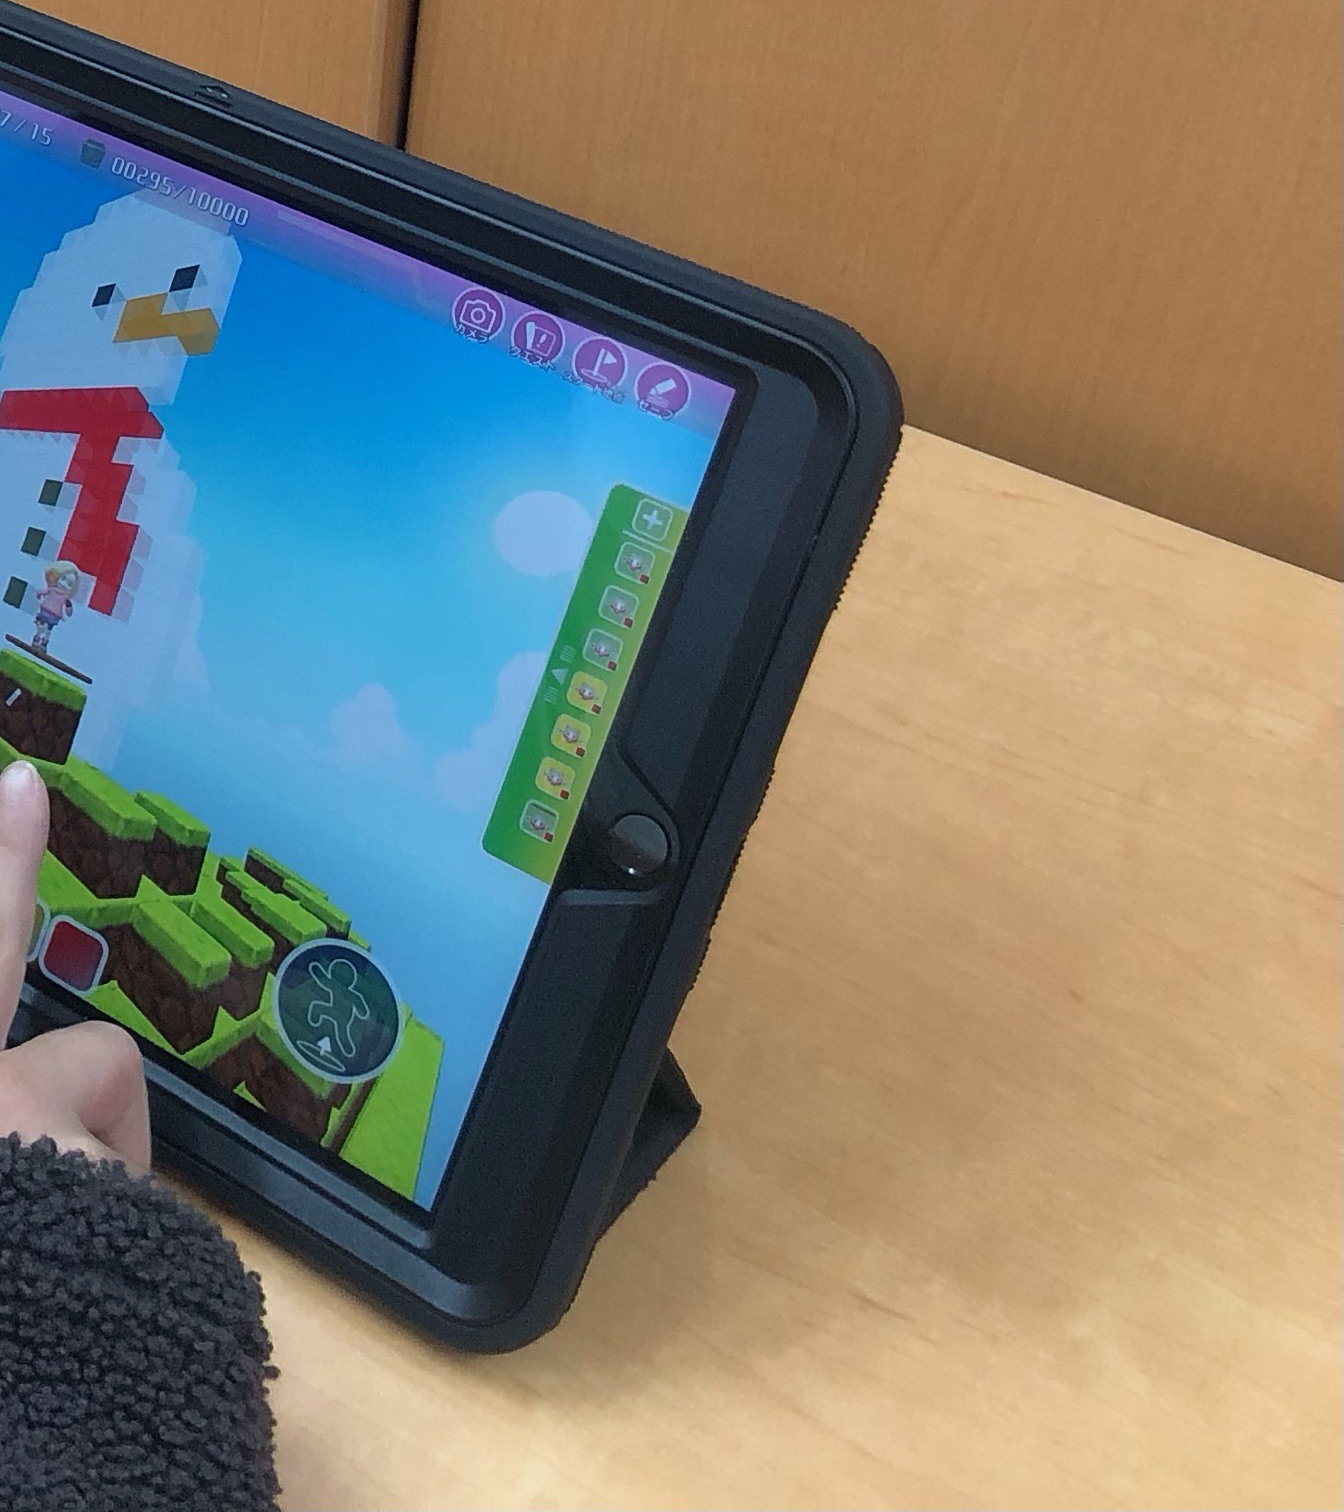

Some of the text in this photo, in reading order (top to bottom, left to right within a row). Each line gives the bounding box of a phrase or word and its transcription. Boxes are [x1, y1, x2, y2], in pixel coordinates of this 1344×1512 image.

[111, 156, 249, 226] 00295/10000
[455, 322, 489, 343] カメラ
[509, 345, 554, 370] クエスト
